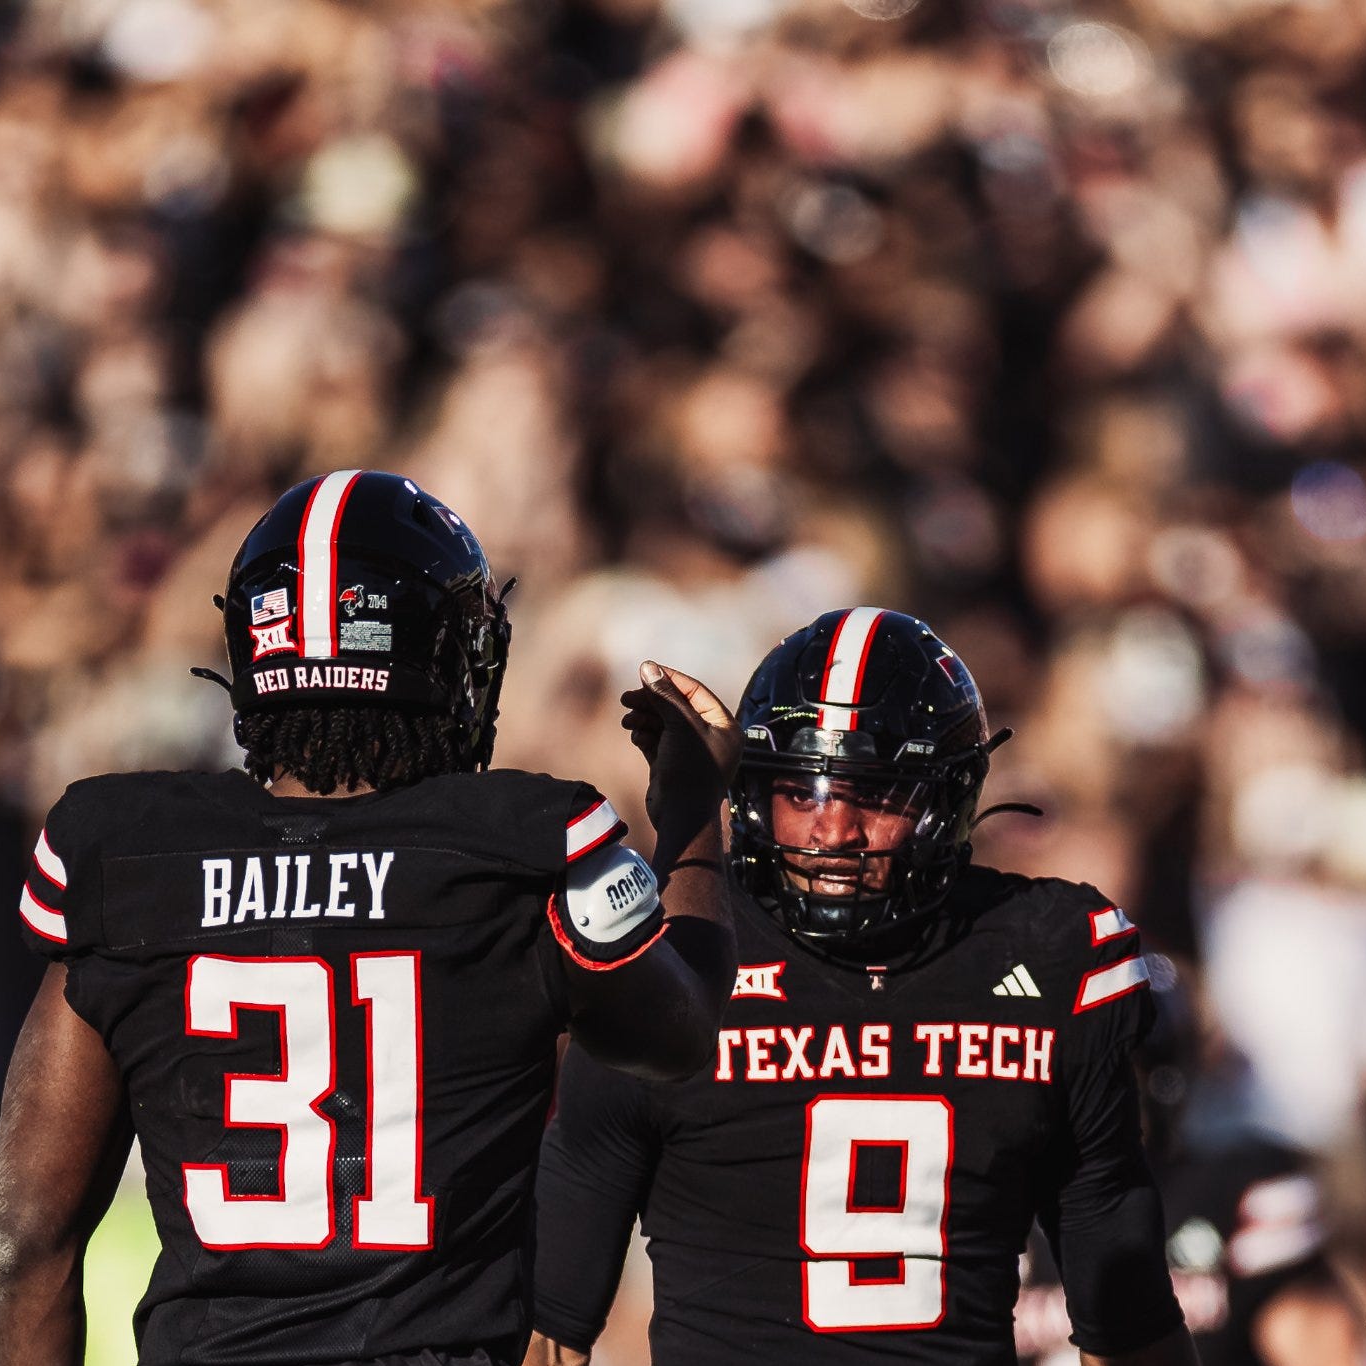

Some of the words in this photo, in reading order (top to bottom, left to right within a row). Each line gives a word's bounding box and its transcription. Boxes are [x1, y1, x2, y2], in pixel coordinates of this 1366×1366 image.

[253, 668, 290, 695] RED
[294, 666, 390, 692] RAIDERS
[201, 852, 394, 928] BAILEY
[715, 1024, 891, 1082] TEXAS
[914, 1023, 1055, 1084] TECH
[184, 950, 434, 1250] 31
[799, 1093, 955, 1333] 9
